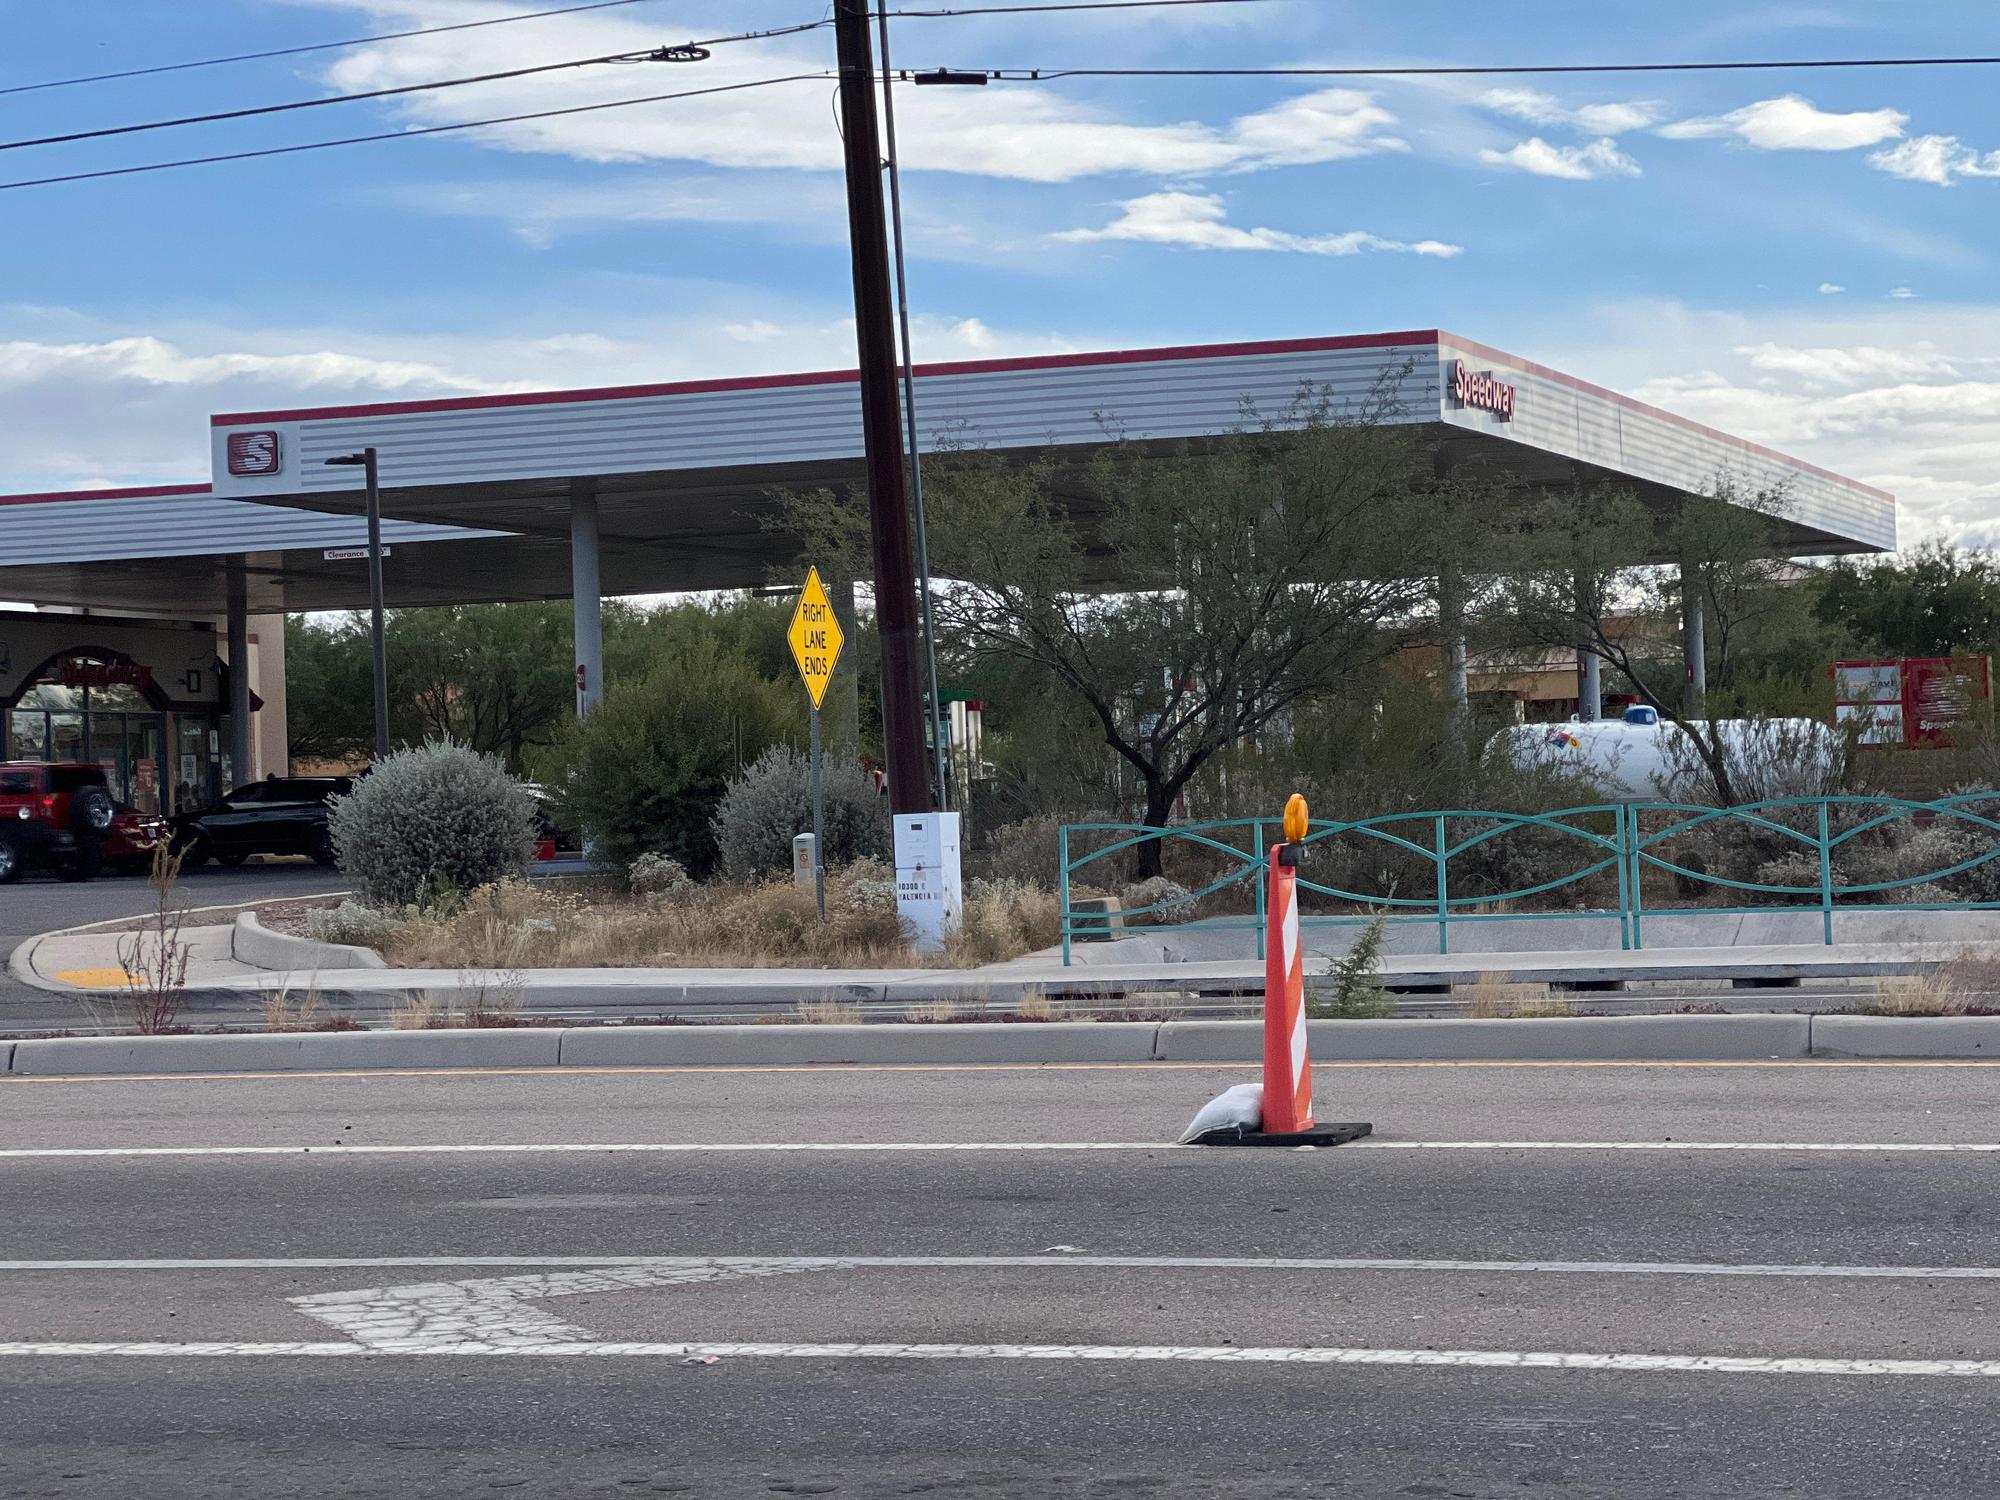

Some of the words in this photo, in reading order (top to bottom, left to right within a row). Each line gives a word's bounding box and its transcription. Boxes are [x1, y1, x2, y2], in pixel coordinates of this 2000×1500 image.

[1455, 359, 1516, 421] Speedway
[327, 551, 364, 559] Clearance
[803, 603, 826, 622] RIGHT
[804, 630, 826, 649] LANE
[805, 656, 827, 675] ENDS
